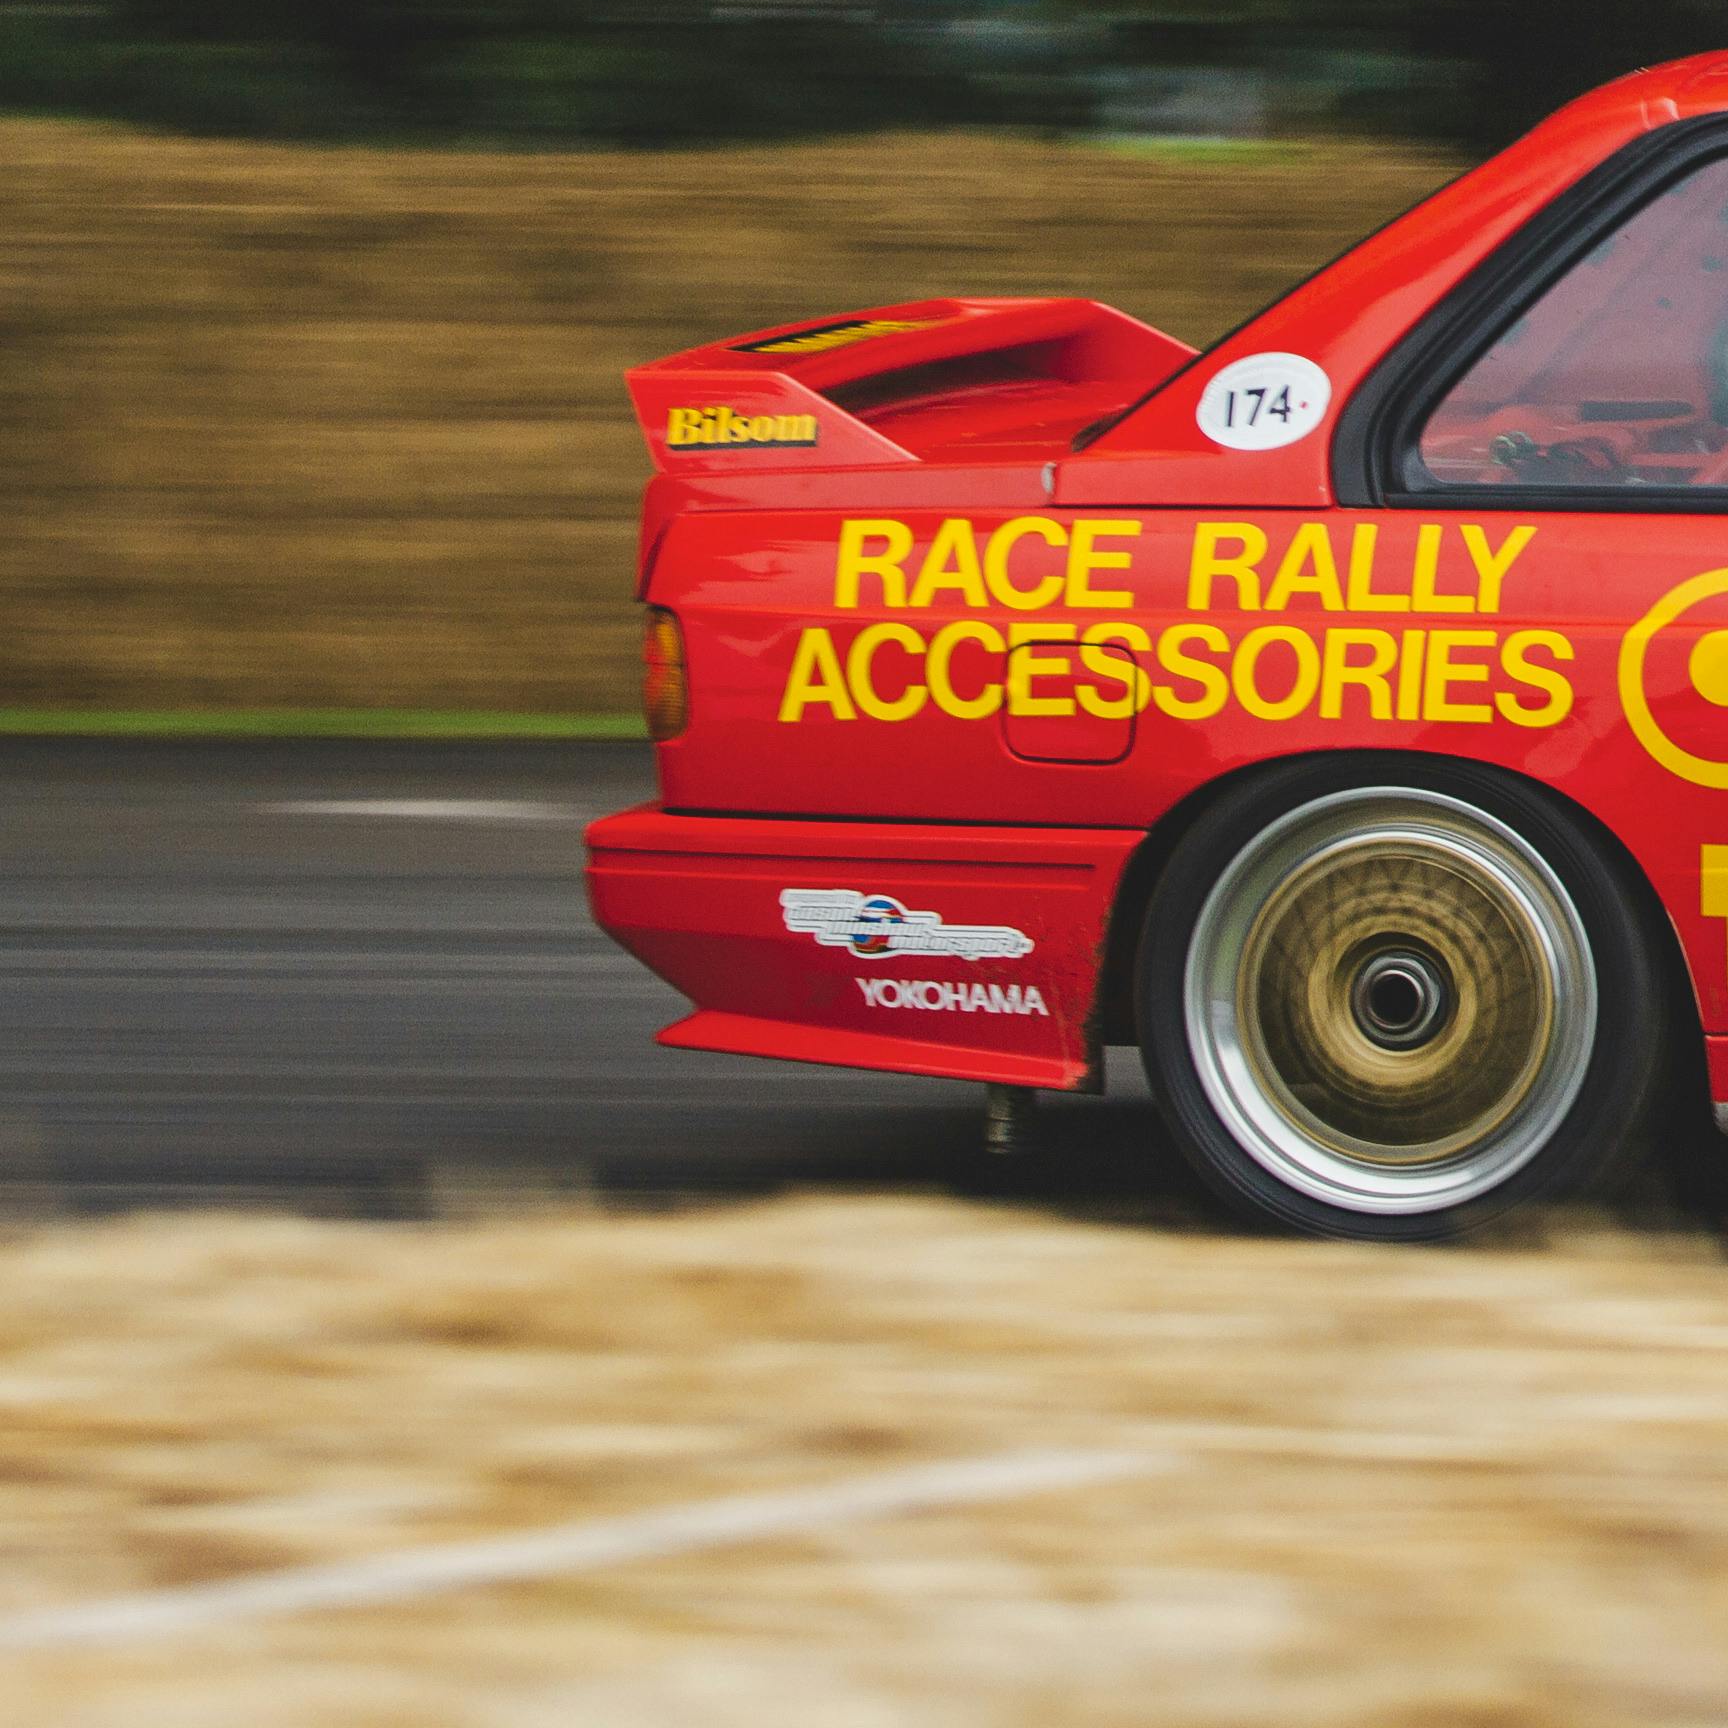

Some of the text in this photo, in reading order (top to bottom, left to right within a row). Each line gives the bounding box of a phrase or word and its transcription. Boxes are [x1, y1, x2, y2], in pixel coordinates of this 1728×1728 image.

[666, 405, 818, 446] Bilsom
[1226, 384, 1291, 427] 174
[833, 517, 1538, 614] RACE RALLY
[777, 620, 1576, 728] ACCESSORIES
[854, 976, 1050, 1017] YOKOHAMA
